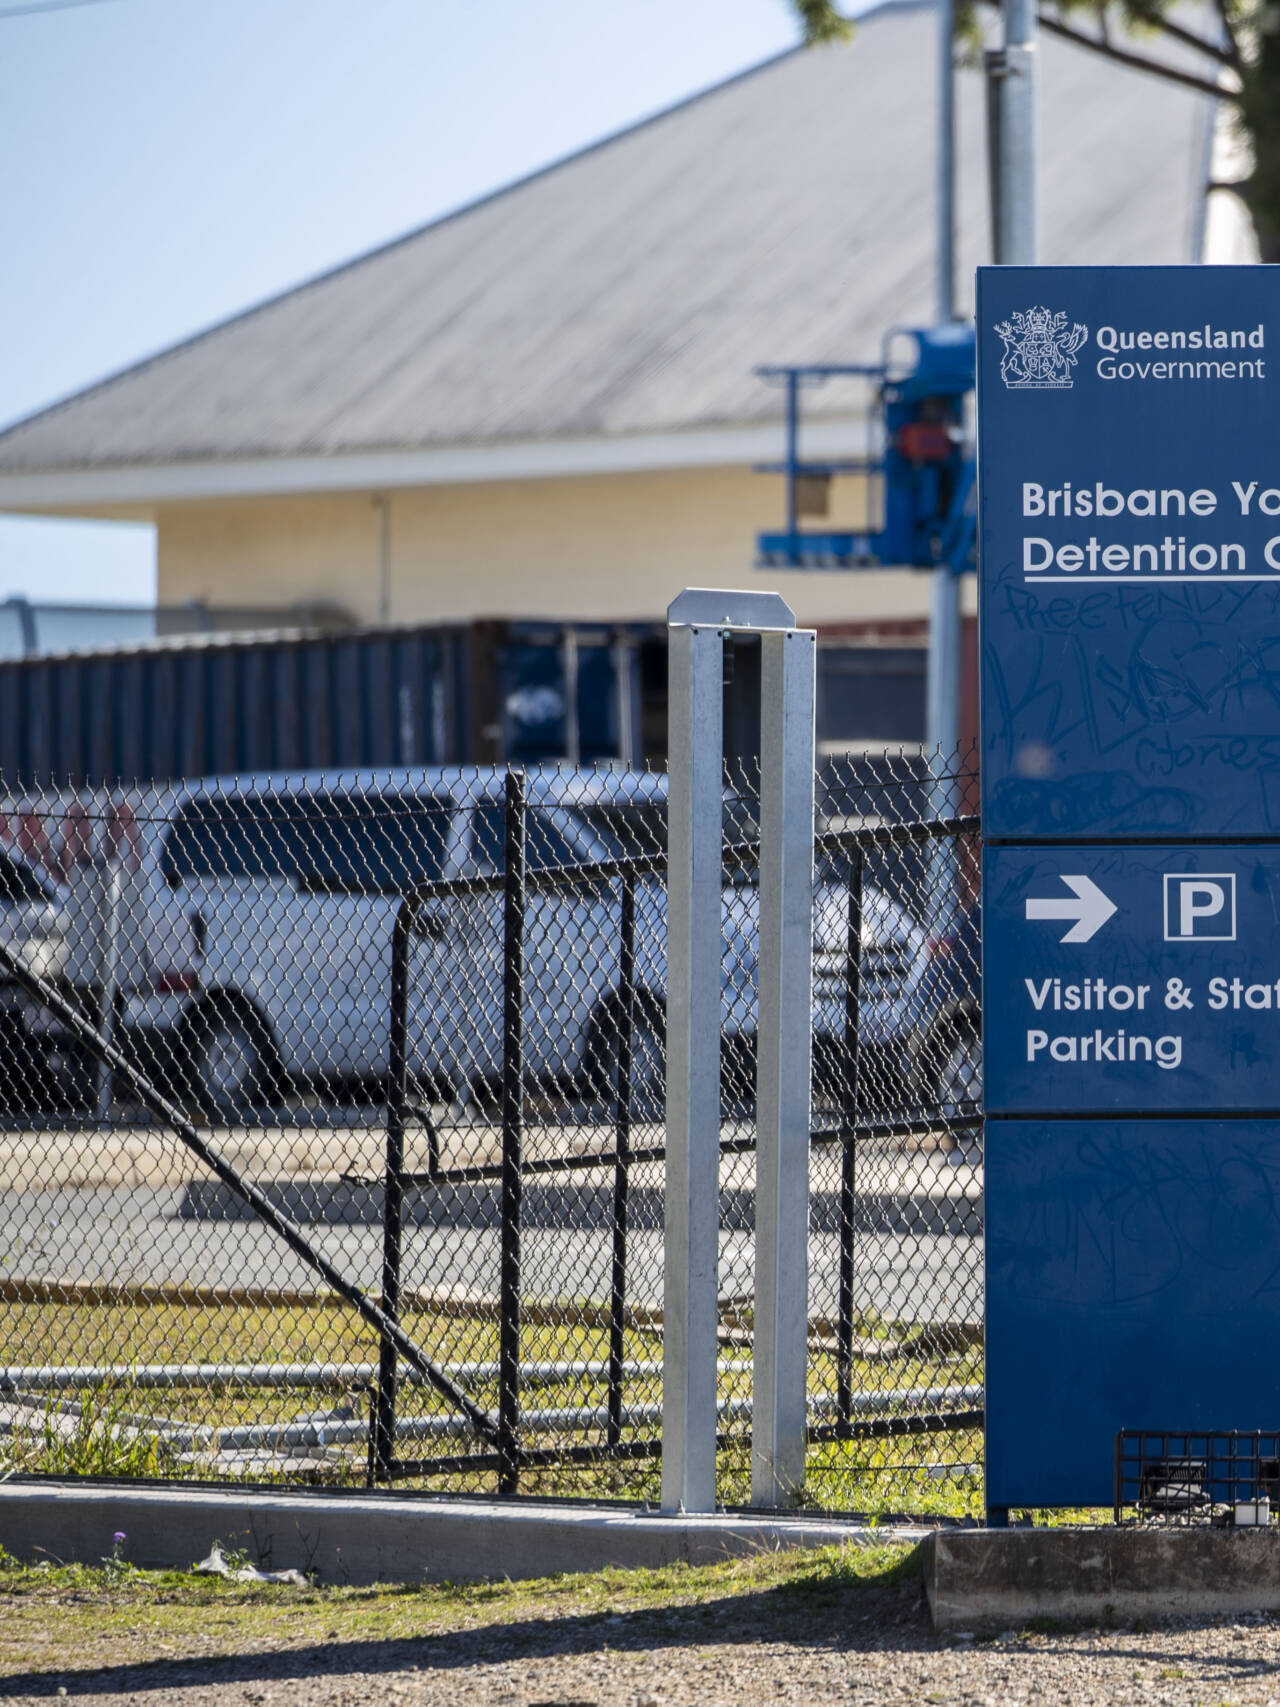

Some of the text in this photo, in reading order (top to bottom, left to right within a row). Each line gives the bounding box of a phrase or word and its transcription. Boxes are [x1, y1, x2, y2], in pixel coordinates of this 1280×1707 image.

[1096, 324, 1266, 353] Queensland
[1096, 357, 1266, 380] Government
[1022, 482, 1218, 518] Brisbane
[1022, 536, 1246, 572] Detention
[1179, 880, 1226, 937] P
[1024, 977, 1151, 1011] Visitor
[1164, 977, 1194, 1010] &
[1026, 1029, 1183, 1070] Parking
